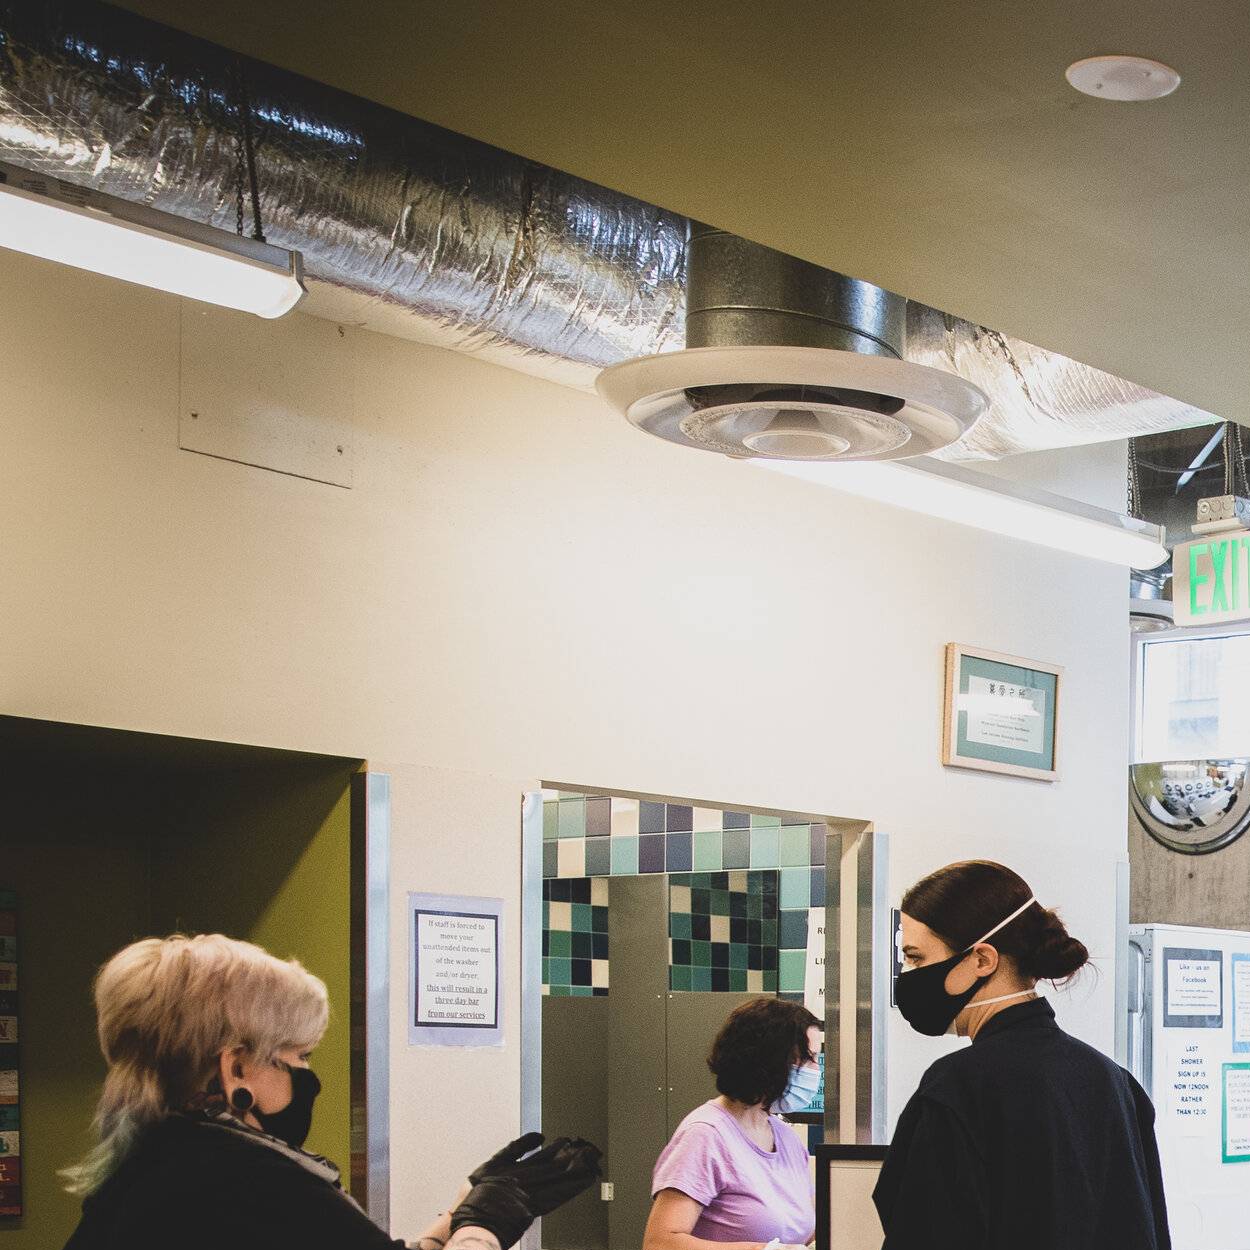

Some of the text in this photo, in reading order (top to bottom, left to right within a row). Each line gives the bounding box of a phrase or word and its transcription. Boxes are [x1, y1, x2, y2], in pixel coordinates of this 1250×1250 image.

[434, 920, 449, 928] staff
[457, 922, 477, 930] forced
[459, 934, 474, 942] your
[422, 944, 460, 952] unattended
[462, 945, 479, 953] items
[455, 958, 479, 966] washer
[426, 983, 439, 992] this
[441, 984, 454, 992] will
[455, 984, 475, 993] result
[435, 996, 453, 1004] three
[454, 996, 466, 1005] day
[428, 1009, 445, 1018] from
[459, 1011, 486, 1019] services
